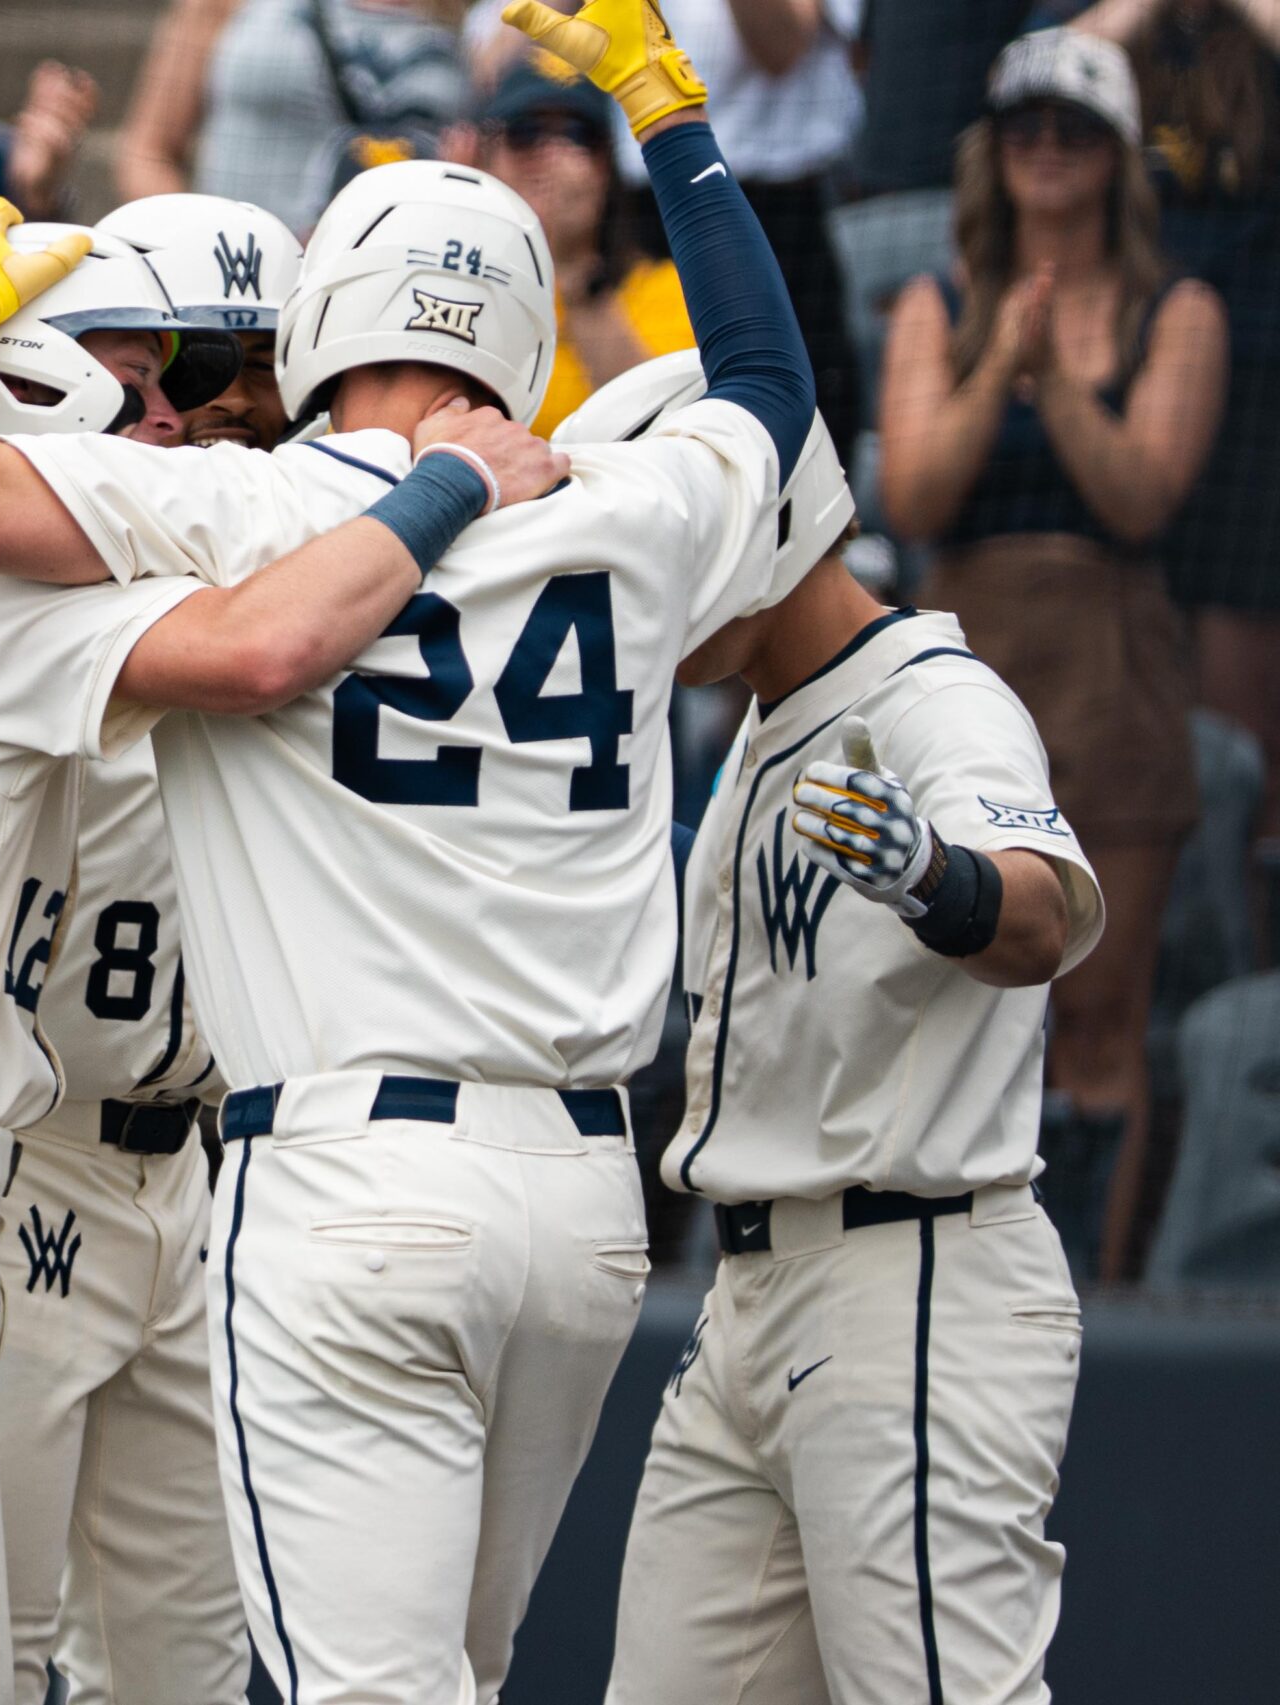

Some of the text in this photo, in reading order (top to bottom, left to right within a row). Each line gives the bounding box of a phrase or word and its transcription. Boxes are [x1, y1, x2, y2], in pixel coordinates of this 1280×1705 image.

[442, 238, 483, 276] 24
[404, 288, 484, 346] XII
[332, 570, 634, 812] 24
[977, 794, 1070, 837] XII
[4, 876, 69, 1015] 12
[84, 899, 161, 1021] 8
